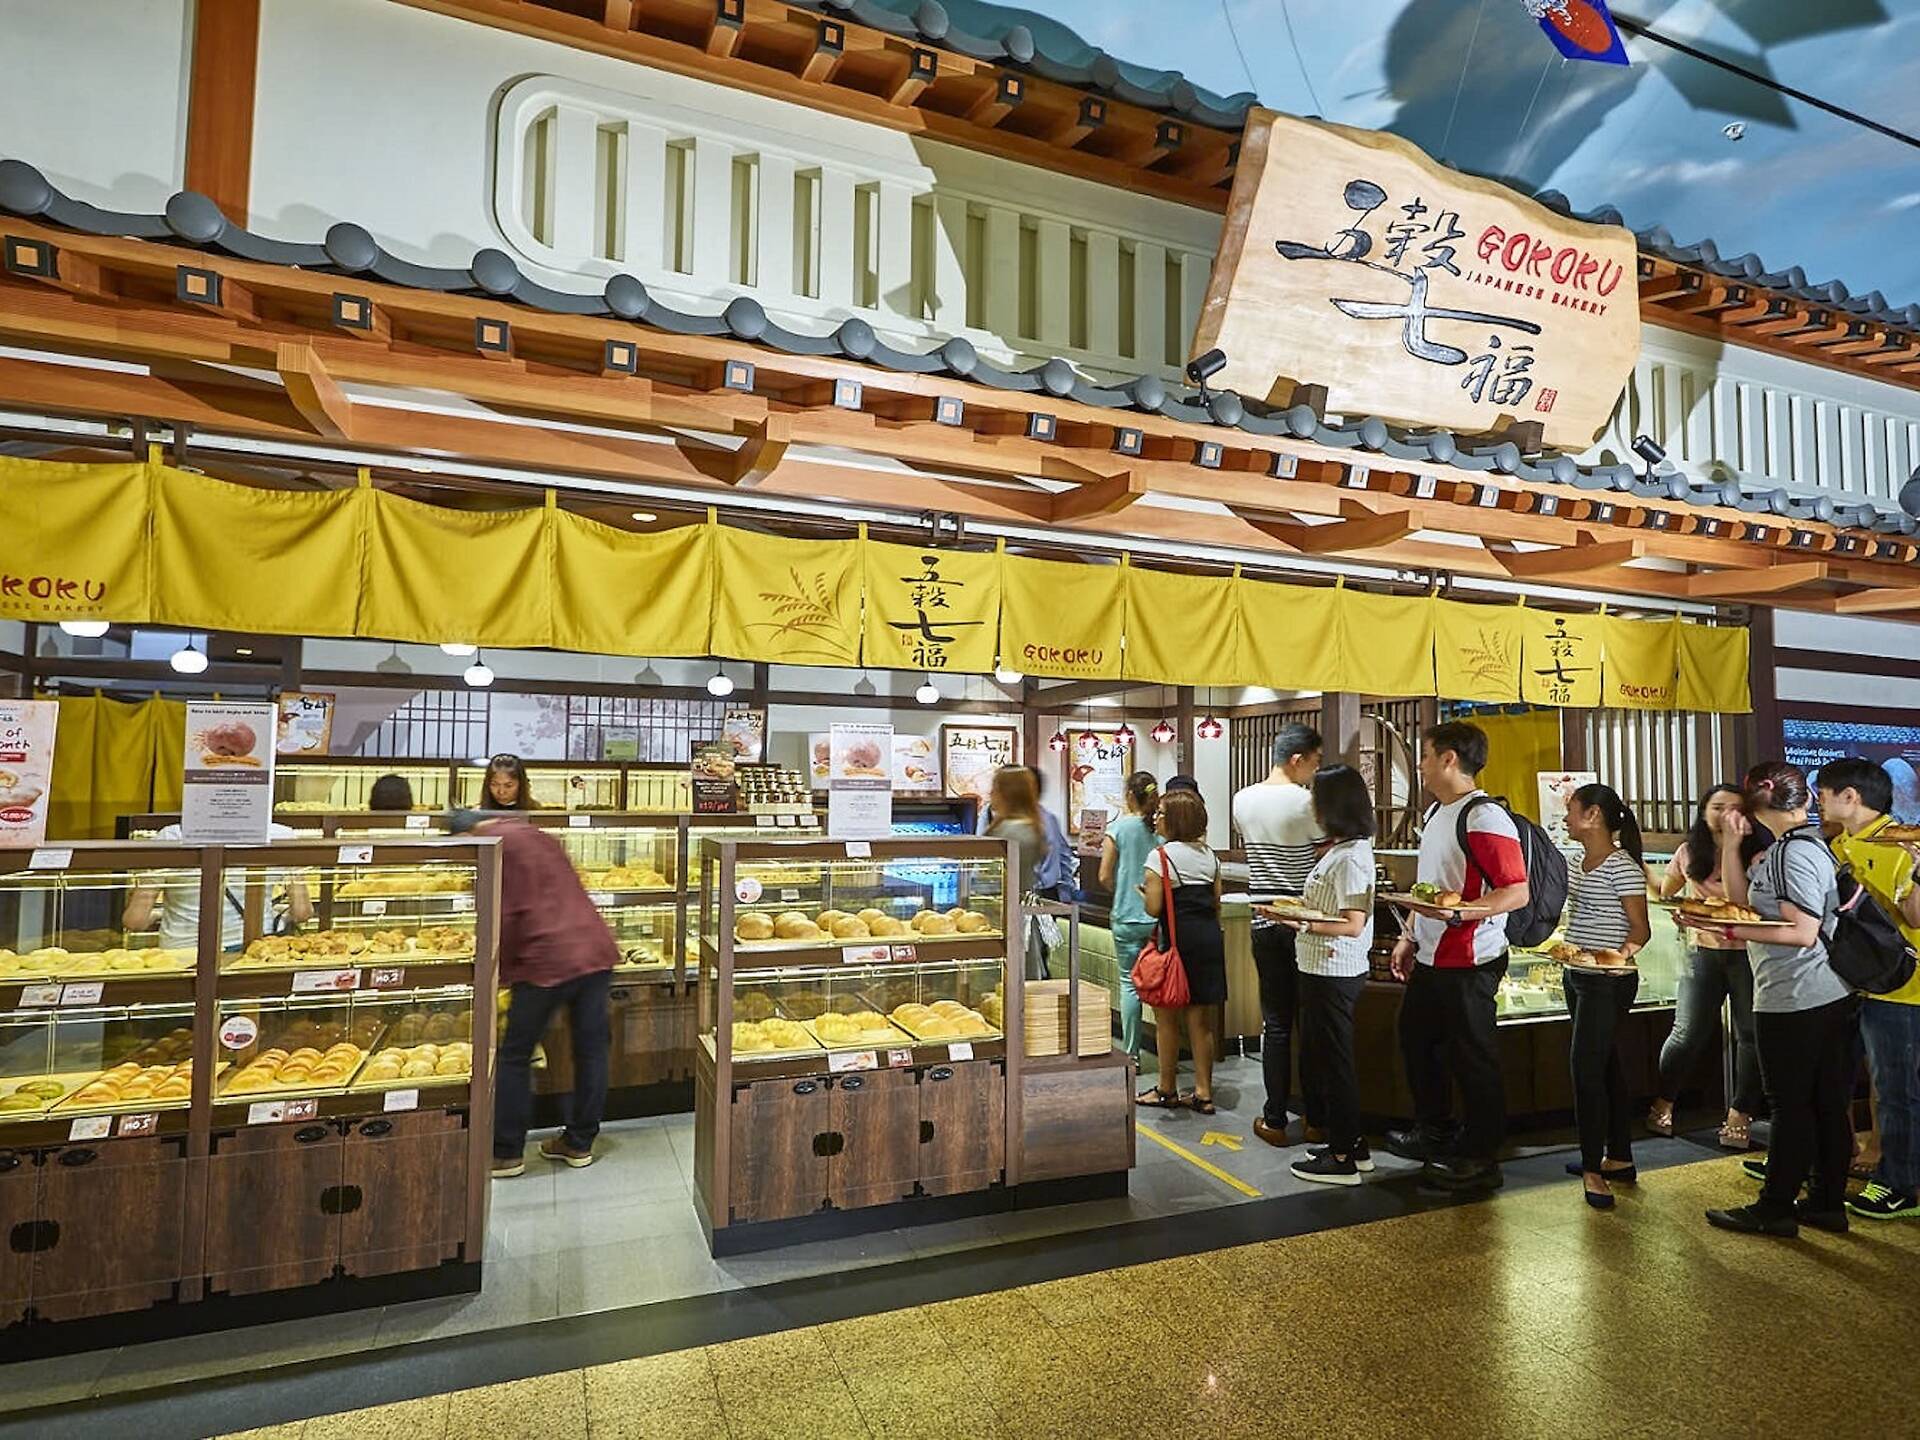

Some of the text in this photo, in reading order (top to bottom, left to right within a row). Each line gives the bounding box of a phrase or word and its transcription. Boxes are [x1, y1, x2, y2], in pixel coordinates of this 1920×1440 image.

[1477, 225, 1623, 297] GOKOKU
[1466, 270, 1607, 316] JAPANESE BAKERY
[1023, 643, 1103, 665] GOKOKU
[1620, 683, 1669, 699] GOKOKU
[6, 727, 22, 738] of
